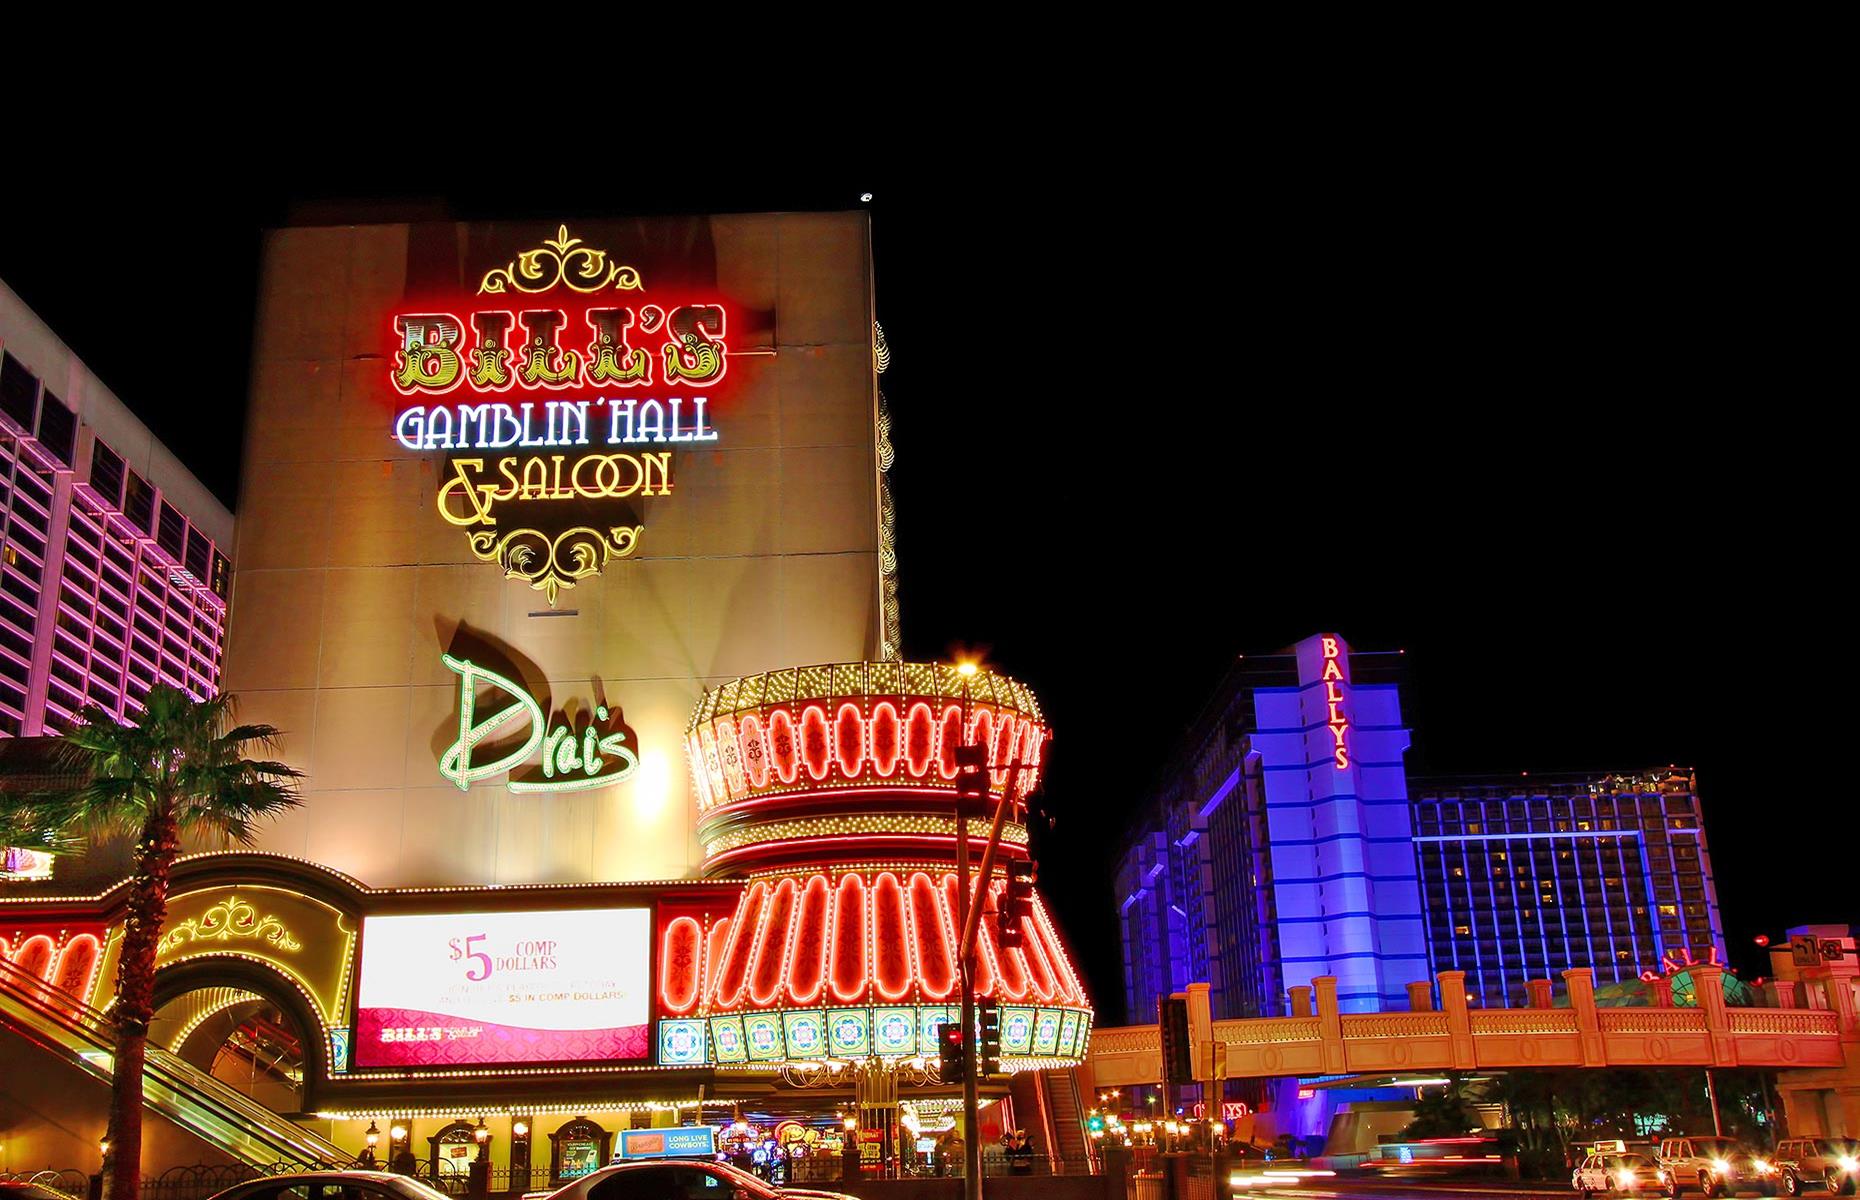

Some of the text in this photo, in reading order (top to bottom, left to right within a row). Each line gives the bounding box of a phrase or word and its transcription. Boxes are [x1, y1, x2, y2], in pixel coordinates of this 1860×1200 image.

[390, 304, 728, 396] BILL'S
[396, 396, 719, 450] GAMBLIN' HALL
[437, 451, 673, 526] & SALOON
[516, 941, 558, 956] COMP
[496, 956, 558, 972] DOLLARS
[525, 993, 535, 1002] IN
[539, 992, 570, 1002] COMP
[573, 991, 624, 1001] DOLLARS
[668, 1134, 708, 1143] LONG LIVE
